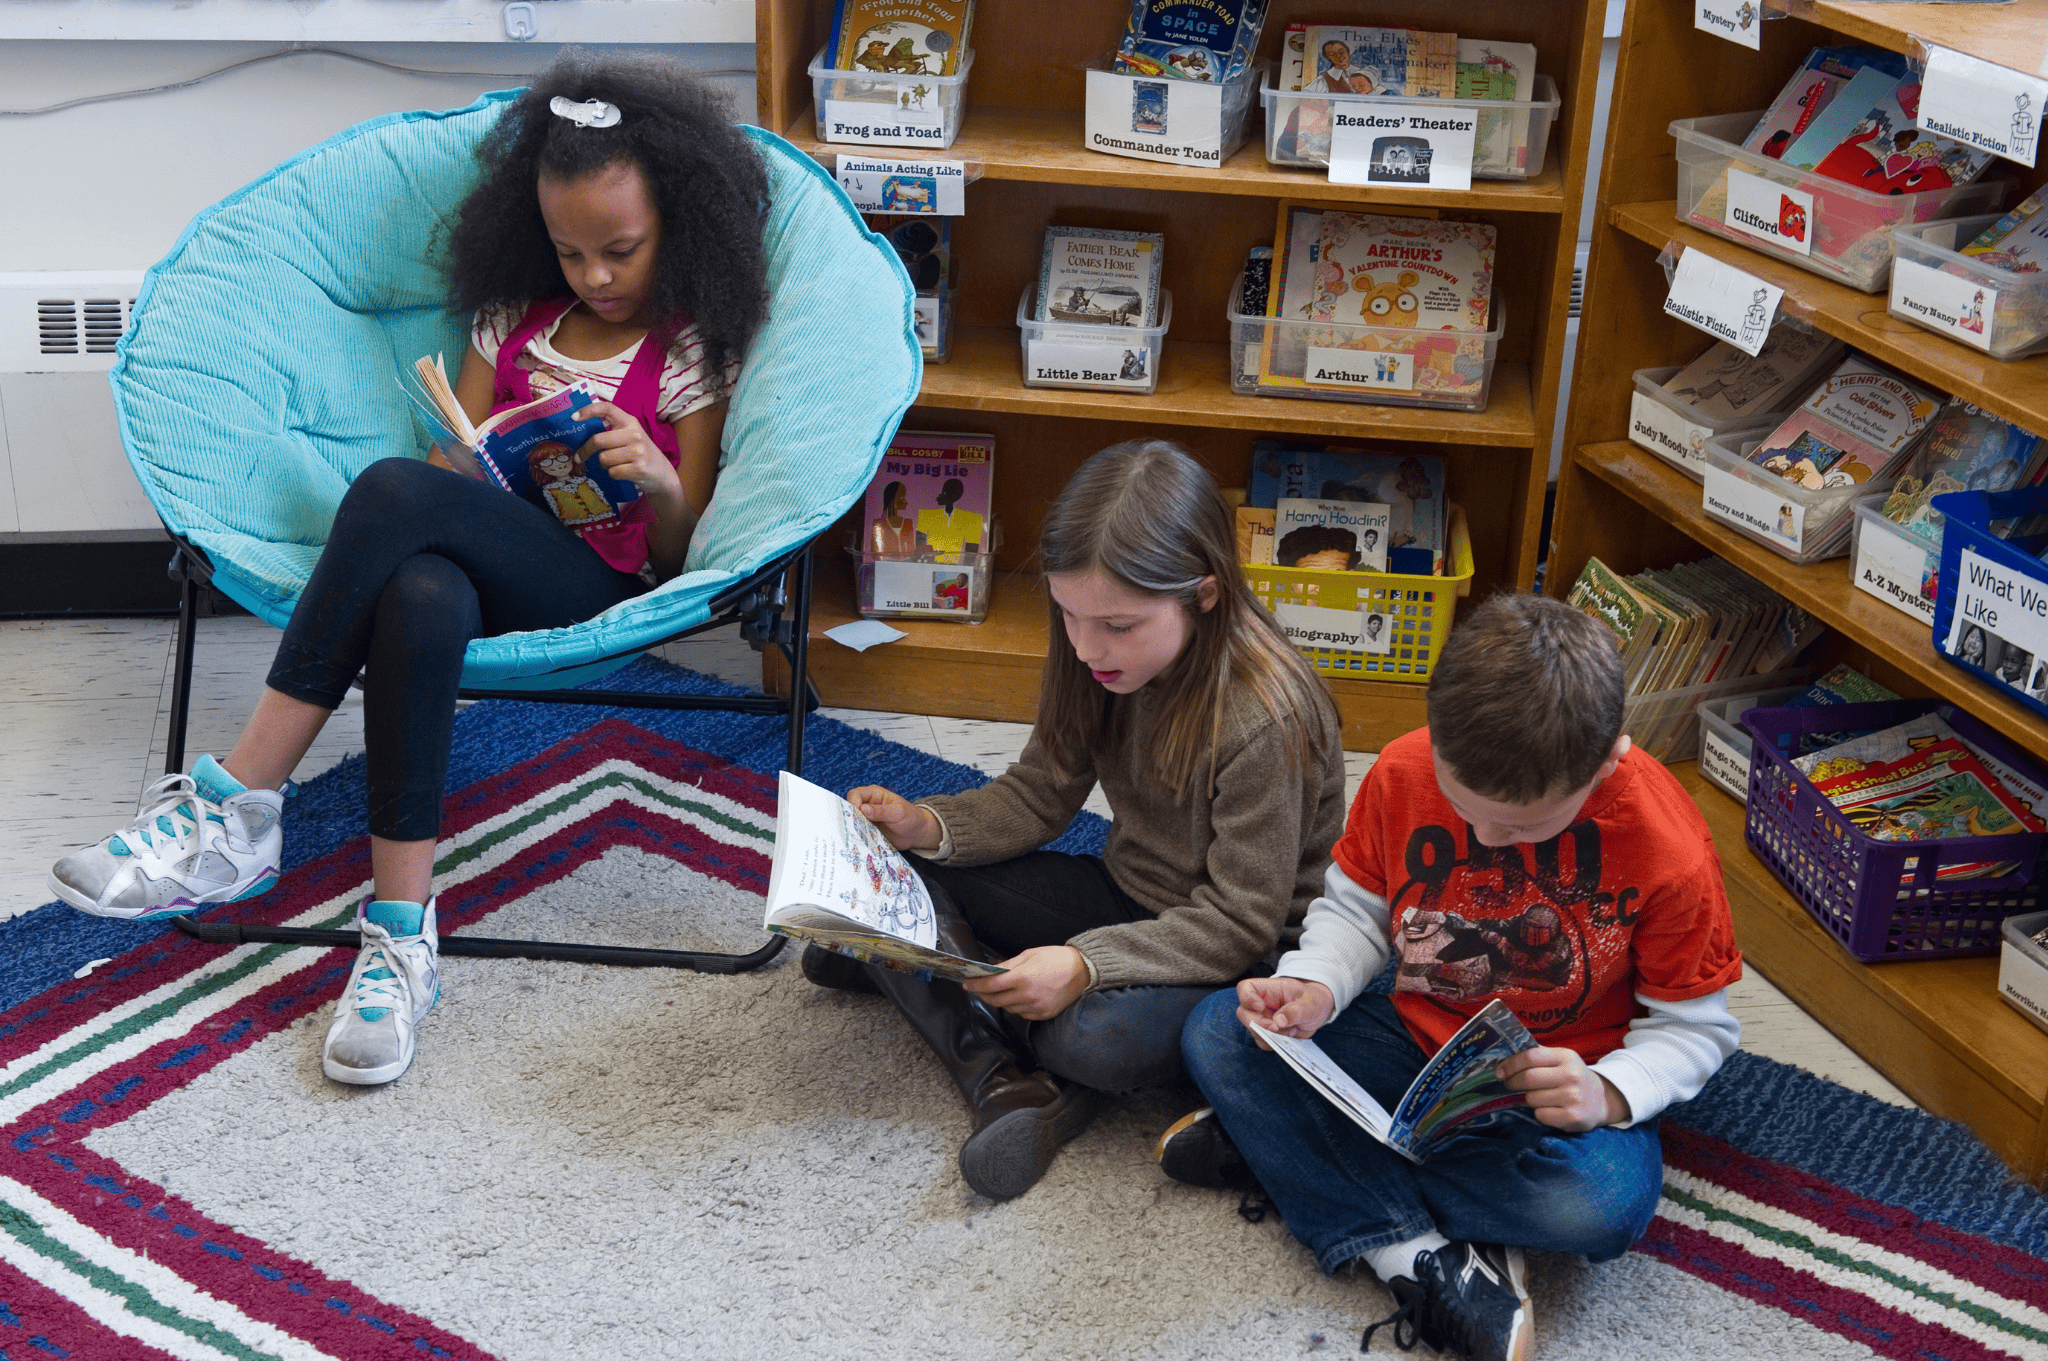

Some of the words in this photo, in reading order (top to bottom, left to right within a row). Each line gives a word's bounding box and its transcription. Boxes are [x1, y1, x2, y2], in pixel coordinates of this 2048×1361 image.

[860, 0, 894, 11] Frog
[926, 1, 956, 22] Toad
[874, 8, 936, 23] Together
[1152, 0, 1213, 14] COMMANDER
[1215, 5, 1235, 26] TOAD
[1187, 8, 1199, 19] in
[1703, 8, 1736, 32] Mystery
[1161, 15, 1220, 36] SPACE
[1172, 32, 1187, 40] JANE
[1189, 34, 1208, 43] YOLEN
[1340, 30, 1372, 42] The
[1381, 33, 1421, 46] Elves
[1354, 43, 1382, 53] and
[1392, 43, 1417, 56] the
[834, 123, 870, 138] Frog
[873, 126, 901, 137] and
[905, 126, 942, 139] Toad
[1409, 117, 1473, 131] Theater
[1926, 116, 1970, 141] Realistic
[1972, 131, 2008, 154] Fiction
[1093, 133, 1180, 157] Commander
[1183, 146, 1220, 160] Toad
[844, 162, 893, 173] Animals
[894, 164, 934, 176] Acting
[936, 166, 962, 176] Like
[854, 202, 883, 212] eople
[1733, 207, 1779, 235] Clifford
[1067, 241, 1104, 255] FATHER
[1109, 245, 1140, 258] BEAR
[1367, 244, 1443, 262] ARTHUR'S
[1068, 255, 1101, 268] COMES
[1104, 258, 1135, 271] HOME
[1349, 260, 1399, 275] VALENTINE
[1401, 260, 1459, 285] COUNTDOWN
[1665, 298, 1704, 324] Realistic
[1705, 316, 1737, 340] Fiction
[1903, 296, 1928, 315] Fancy
[1929, 307, 1957, 326] Nancy
[1037, 369, 1078, 380] Little
[1082, 370, 1117, 381] Bear
[1315, 368, 1368, 383] Arthur
[1840, 376, 1882, 387] HENRY
[1881, 380, 1903, 394] AND
[498, 408, 540, 433] BARBARA
[543, 395, 569, 412] PARK
[1823, 407, 1843, 421] Pictures
[1849, 392, 1869, 406] Cold
[1867, 401, 1896, 420] Shivers
[505, 434, 549, 453] Toothless
[549, 423, 586, 438] Wonder
[1635, 421, 1657, 441] Judy
[1659, 432, 1688, 459] Moody
[887, 448, 908, 456] BILL
[912, 450, 945, 458] COSBY
[1930, 437, 1963, 460] Jewel
[886, 461, 910, 476] My
[913, 463, 941, 477] Big
[944, 464, 968, 477] Lie
[1318, 504, 1331, 512] Who
[1708, 496, 1730, 514] Henry
[1731, 509, 1744, 520] and
[1745, 513, 1770, 532] Mudge
[1285, 509, 1326, 526] Harry
[1329, 511, 1388, 528] Houdini?
[1248, 522, 1275, 536] The
[1863, 569, 1885, 589] A-Z
[1969, 562, 2014, 602] What
[2020, 585, 2047, 617] We
[886, 600, 911, 608] Little
[913, 601, 930, 609] Bill
[1964, 594, 1998, 628] Like
[1284, 626, 1359, 646] Biography
[1706, 741, 1729, 764] Magic
[1730, 759, 1747, 778] Tree
[1704, 757, 1748, 796] Non-Fiction
[1821, 784, 1852, 798] agic
[1851, 771, 1899, 791] School
[1898, 761, 1927, 777] Bus
[2006, 983, 2039, 1013] Horrible
[1461, 1030, 1487, 1049] TOAD
[1419, 1045, 1477, 1103] SPACE
